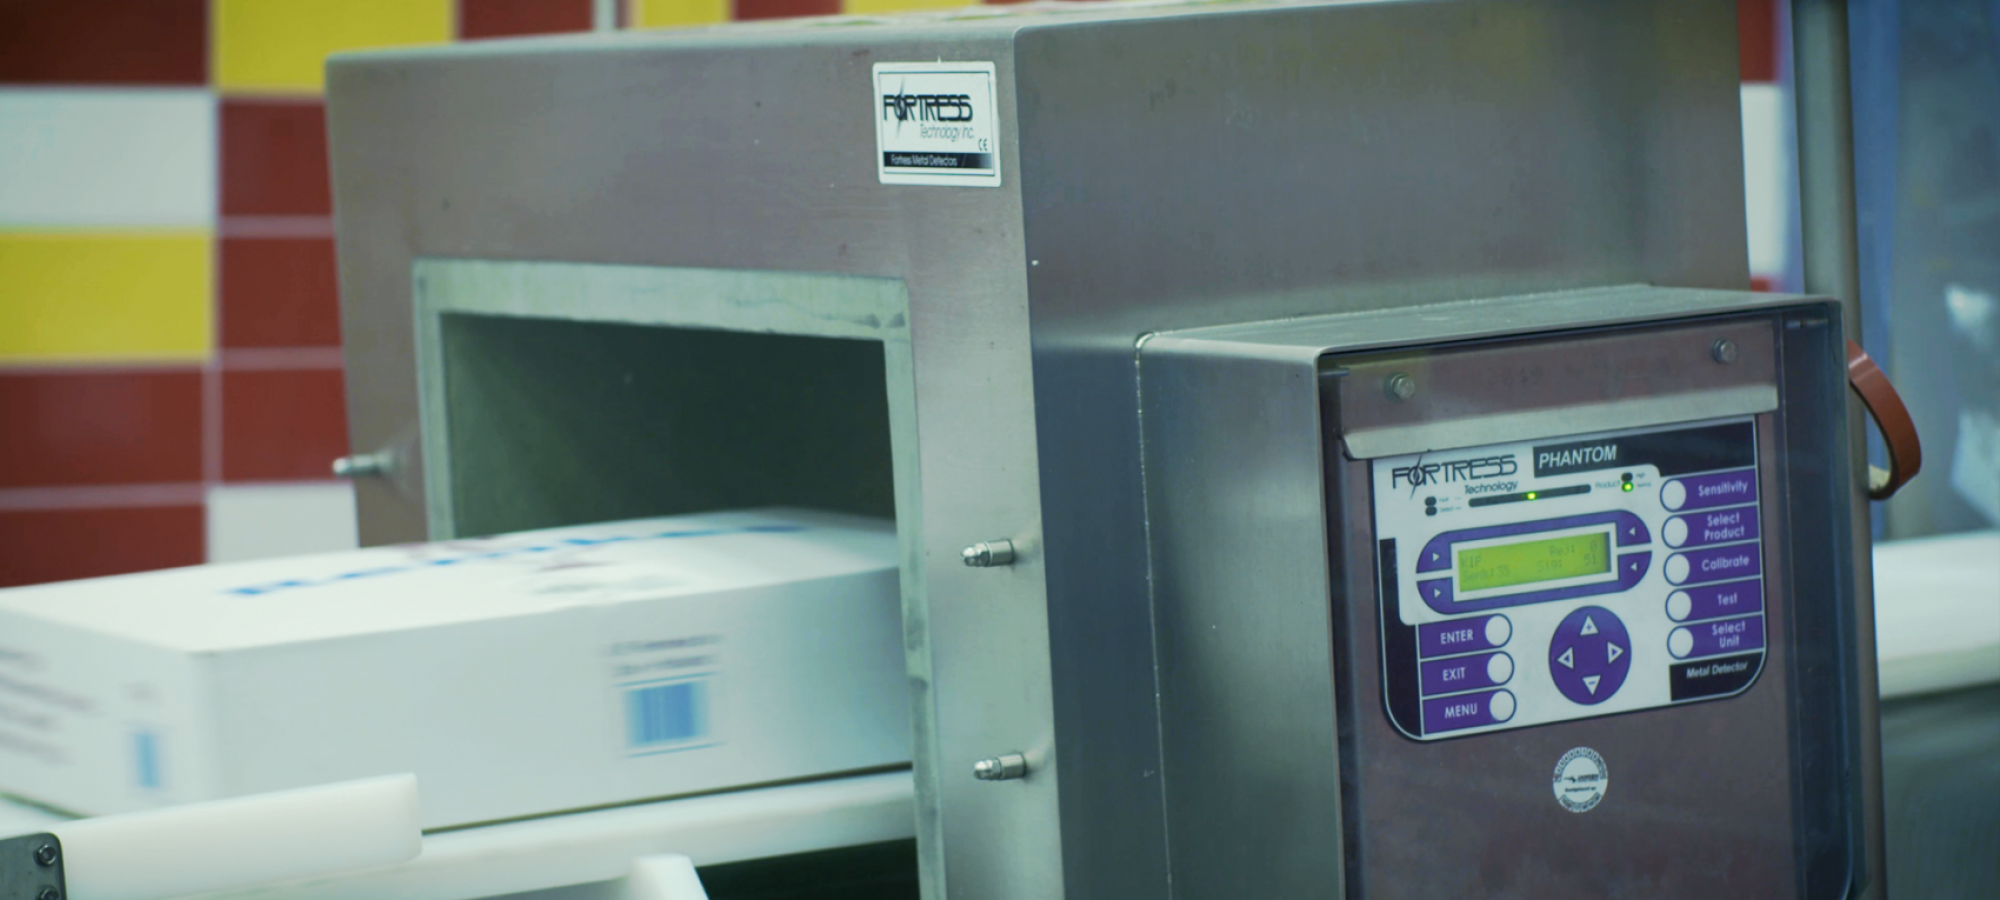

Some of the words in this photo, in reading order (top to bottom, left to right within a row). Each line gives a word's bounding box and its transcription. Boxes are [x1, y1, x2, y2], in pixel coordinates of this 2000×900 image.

[883, 93, 974, 122] FORTRESS
[920, 122, 961, 142] Technology
[1538, 443, 1617, 469] PHANTOM
[1391, 454, 1518, 490] FORTRESS
[1464, 480, 1519, 495] Technology
[1698, 480, 1748, 497] Sensitivity
[1707, 511, 1740, 527] Select
[1704, 525, 1745, 541] Product
[1701, 555, 1750, 572] Calibrate
[1717, 591, 1738, 606] Test
[1440, 628, 1474, 645] ENTER
[1712, 620, 1746, 636] Select
[1719, 634, 1740, 649] Unit
[1442, 666, 1466, 682] EXIT
[1686, 665, 1710, 679] Metal
[1711, 661, 1748, 676] Detector
[1444, 702, 1478, 719] MENU
